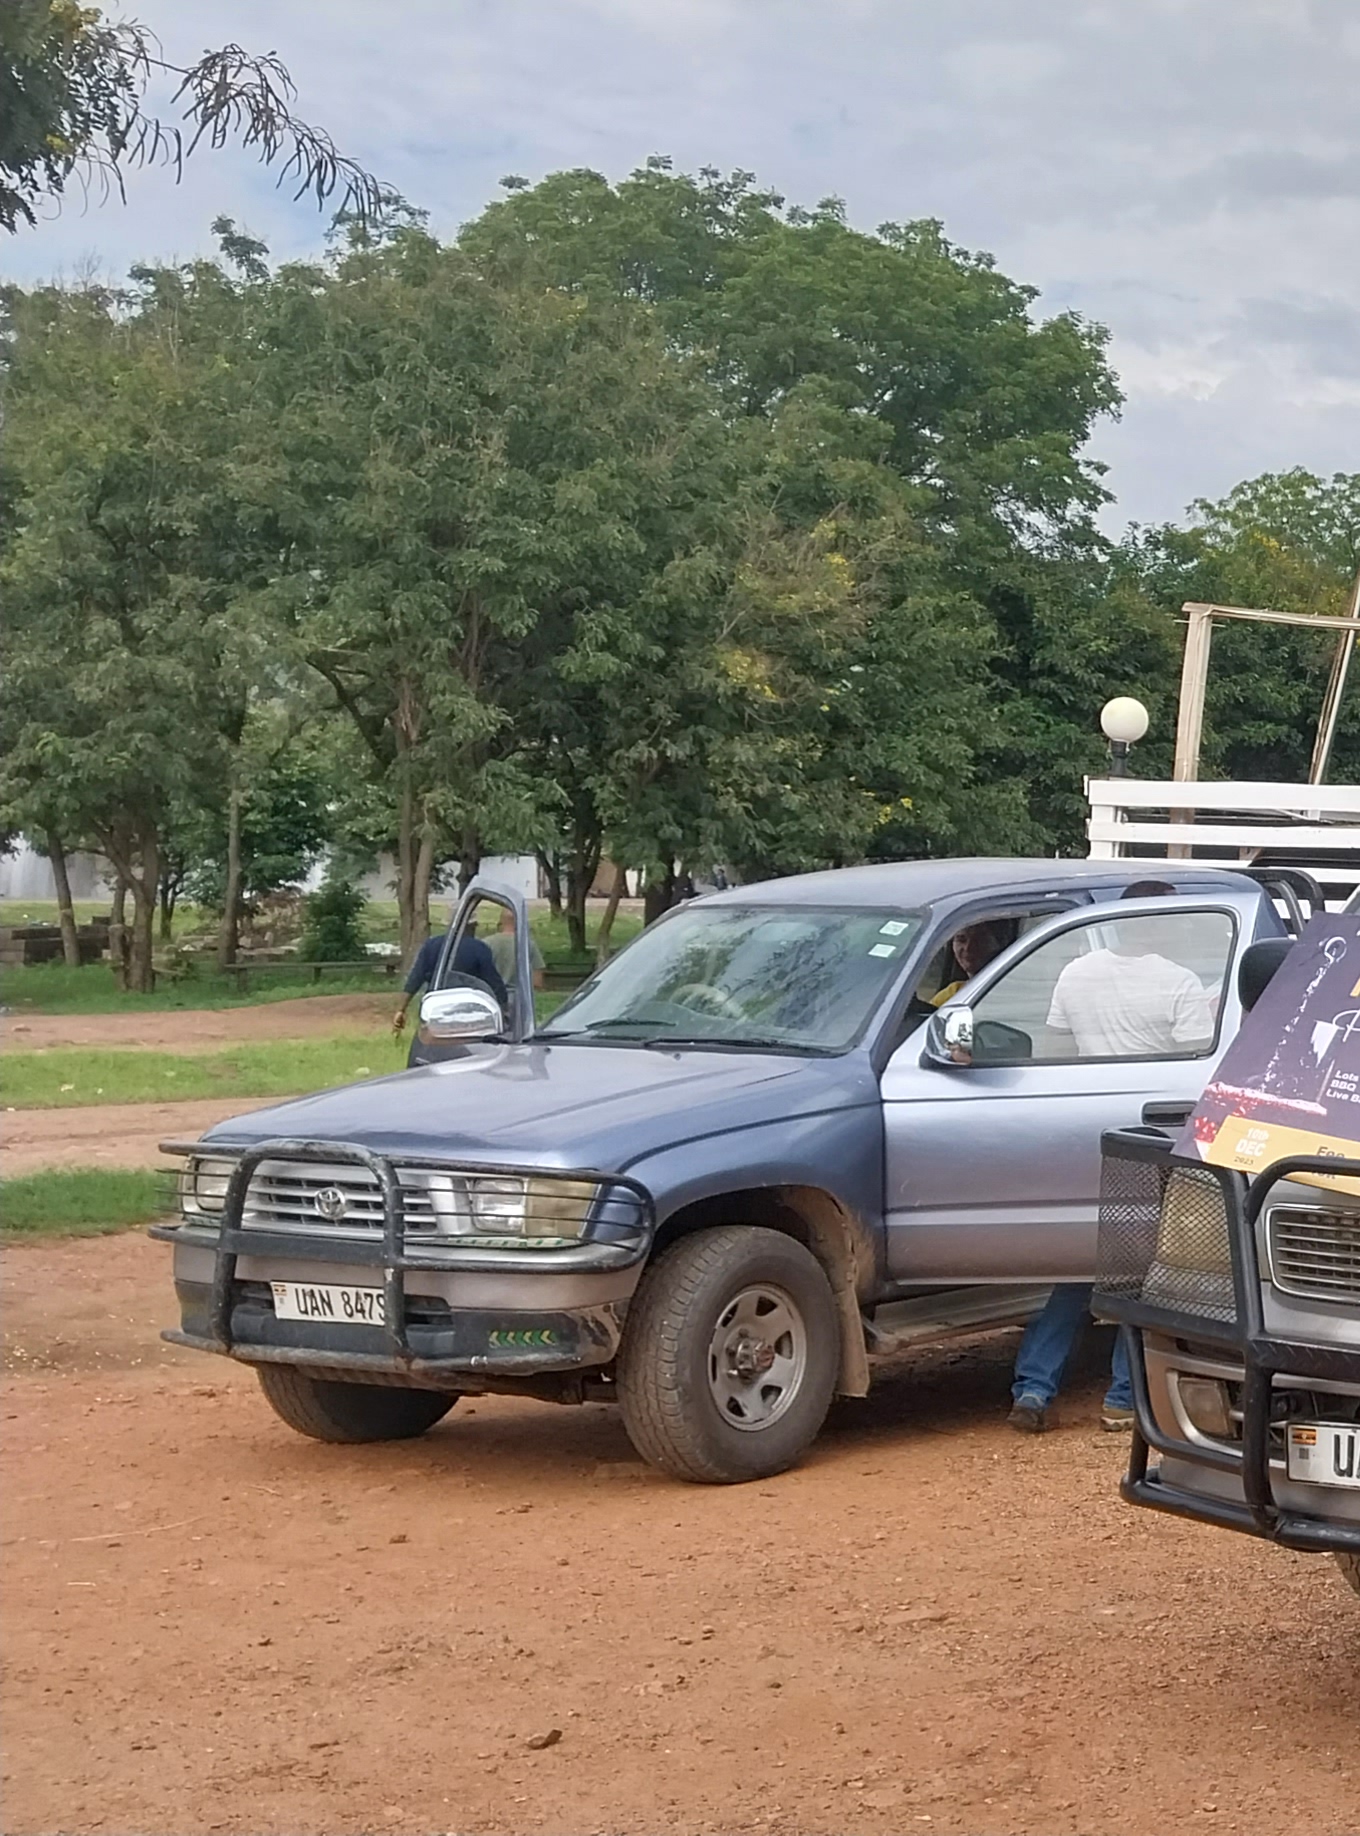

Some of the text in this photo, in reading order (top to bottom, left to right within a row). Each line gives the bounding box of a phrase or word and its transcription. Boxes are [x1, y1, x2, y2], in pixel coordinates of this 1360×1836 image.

[1334, 1069, 1360, 1084] Lots
[1330, 1079, 1357, 1093] BBQ
[1326, 1088, 1350, 1101] Live
[1235, 1138, 1267, 1157] DEC
[295, 1287, 334, 1316] UAN
